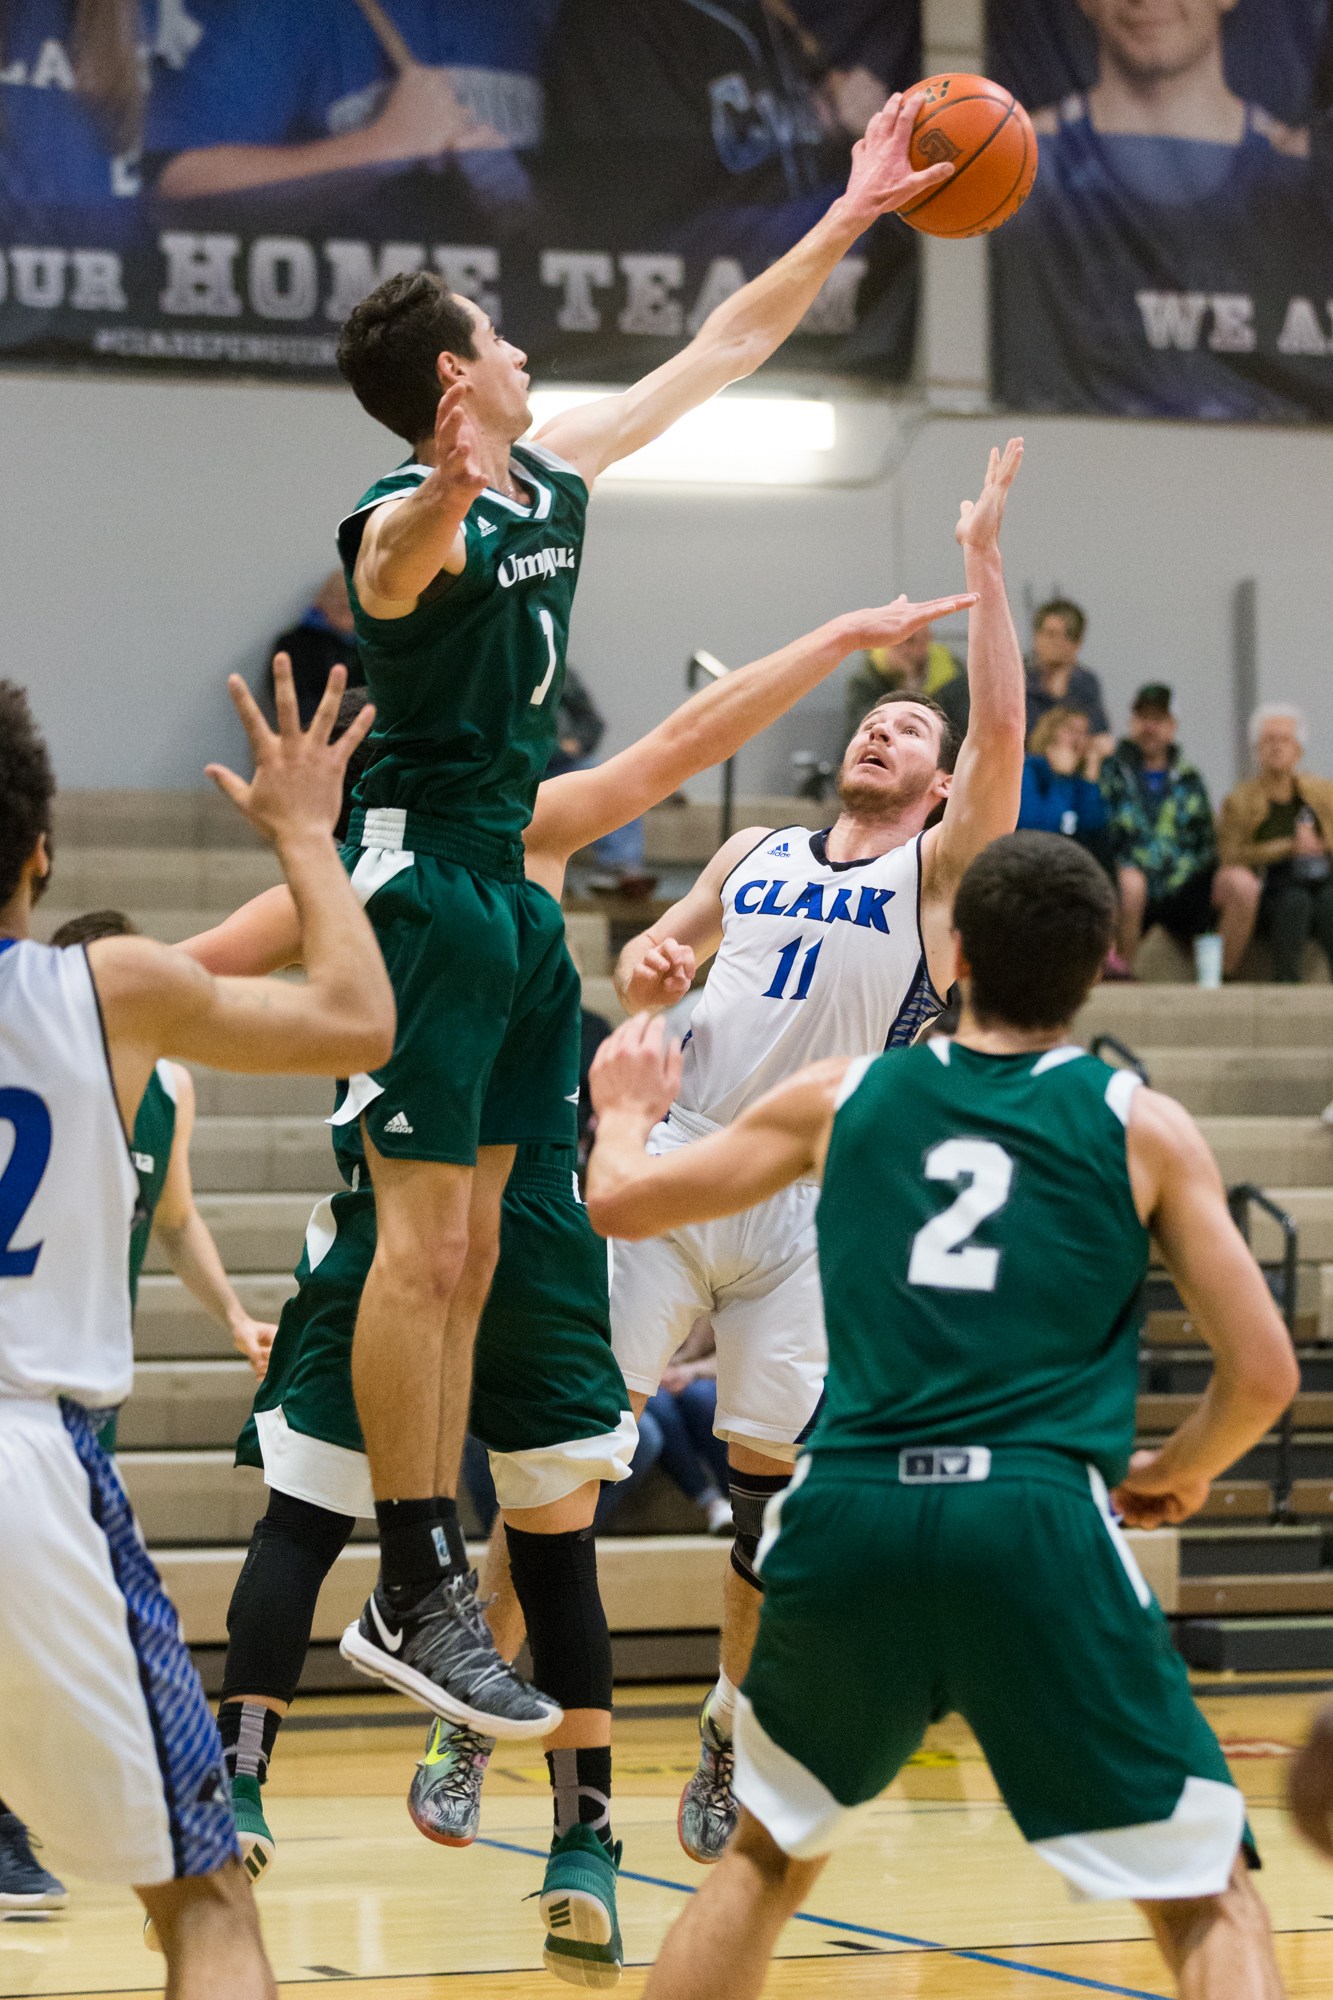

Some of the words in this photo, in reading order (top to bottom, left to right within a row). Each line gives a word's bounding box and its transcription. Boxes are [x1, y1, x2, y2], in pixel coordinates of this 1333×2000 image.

[0, 247, 127, 311] UR
[1135, 290, 1257, 352] WE
[1276, 295, 1333, 355] A
[530, 609, 557, 705] 1
[734, 879, 896, 935] CLARK
[761, 934, 824, 1000] 11
[907, 1138, 1014, 1291] 2
